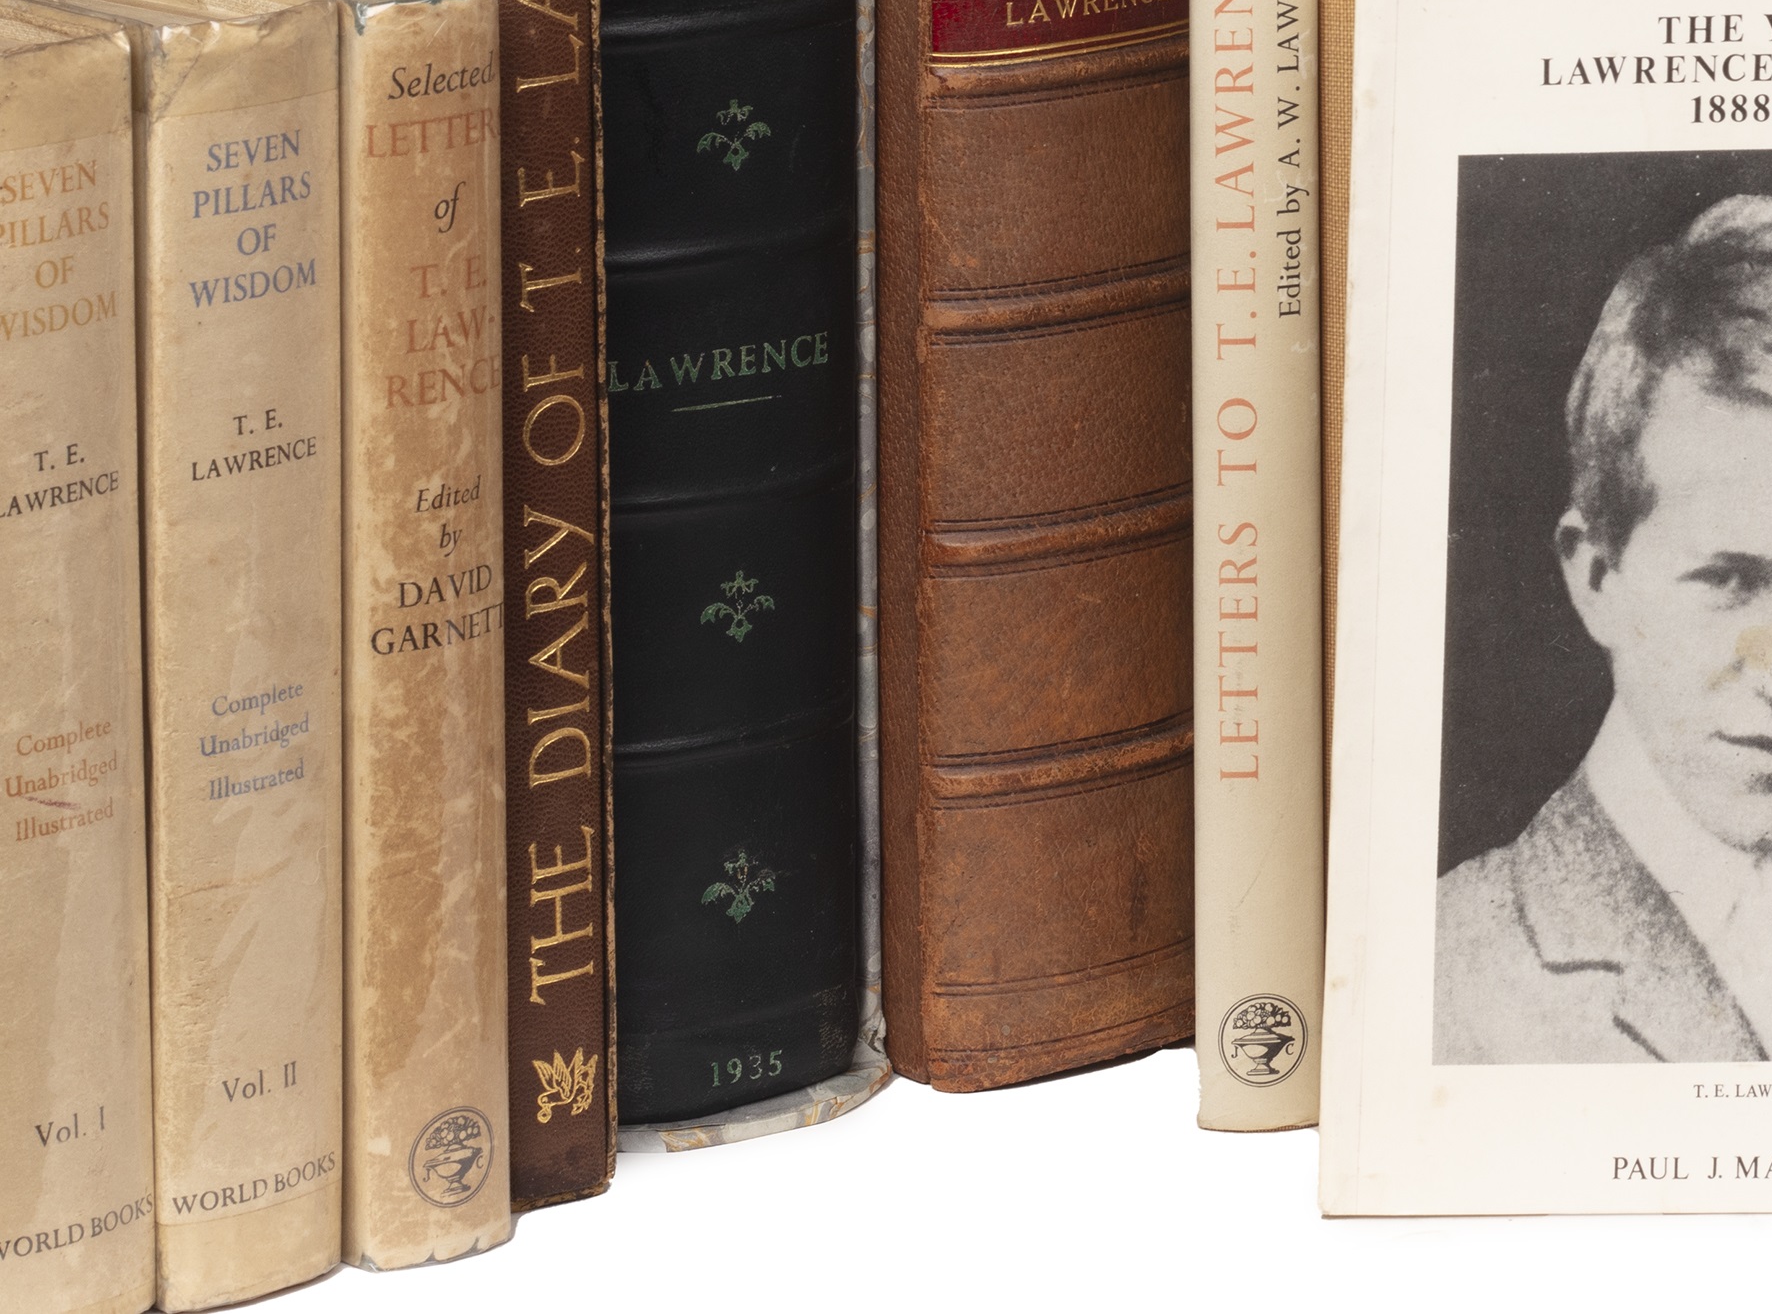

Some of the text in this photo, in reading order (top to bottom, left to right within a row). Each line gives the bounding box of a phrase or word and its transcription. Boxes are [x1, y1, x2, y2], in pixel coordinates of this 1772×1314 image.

[1658, 14, 1745, 45] THE
[387, 50, 496, 102] Selected
[1690, 94, 1772, 124] 1888
[206, 129, 302, 173] SEVEN
[192, 170, 312, 219] PILLARS
[433, 181, 467, 234] of
[1278, 182, 1310, 216] by
[236, 223, 277, 256] OF
[35, 255, 74, 289] OF
[189, 258, 317, 309] WISDOM
[1278, 226, 1302, 319] Edited
[406, 304, 496, 355] LAW-
[607, 331, 830, 392] LAWRENCE
[522, 352, 588, 468] OF
[191, 436, 318, 482] LAWRENCE
[1216, 397, 1258, 487] TO
[414, 474, 482, 514] Edited
[439, 522, 463, 557] by
[398, 563, 494, 609] DAVID
[523, 503, 595, 792] DIARY
[1217, 520, 1259, 782] LETTERS
[212, 681, 305, 718] Complete
[16, 719, 112, 757] Complete
[199, 712, 311, 757] Unabridged
[4, 751, 119, 798] Unabridged
[208, 757, 306, 801] Illustrated
[14, 799, 115, 842] Illustrated
[529, 823, 597, 1007] THE
[221, 1060, 299, 1103] Vol. II
[711, 1048, 784, 1088] 1935
[34, 1110, 87, 1148] Vol.
[172, 1150, 337, 1216] WORLD BOOKS
[1612, 1156, 1689, 1180] PAUL
[1707, 1156, 1723, 1180] J.
[90, 1193, 153, 1237] BOOKS
